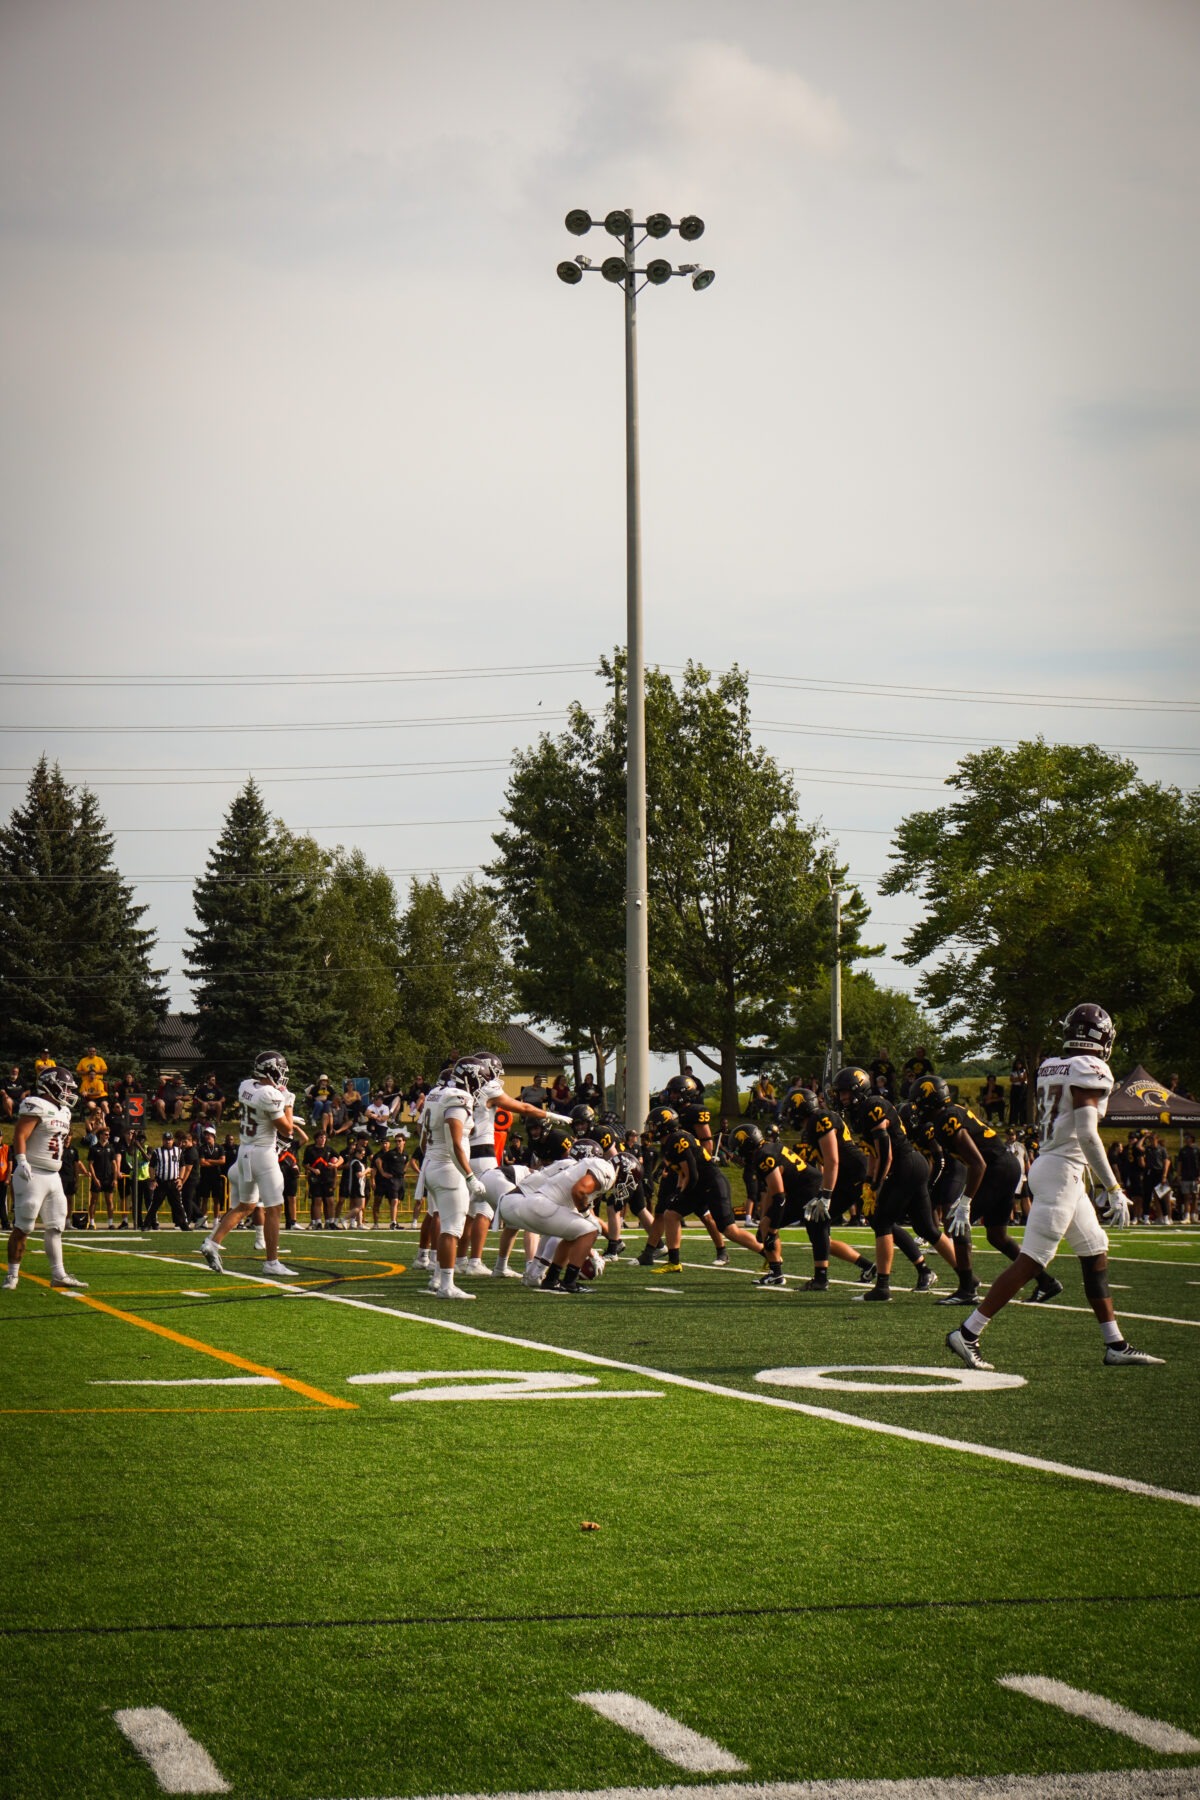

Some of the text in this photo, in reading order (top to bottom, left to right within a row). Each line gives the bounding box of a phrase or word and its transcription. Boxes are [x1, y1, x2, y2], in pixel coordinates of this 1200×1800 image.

[129, 1097, 144, 1117] 3
[868, 1106, 886, 1121] 12
[698, 1111, 710, 1123] 35
[815, 1116, 833, 1133] 43
[942, 1116, 961, 1136] 32
[600, 1133, 611, 1148] 27
[673, 1137, 689, 1154] 26
[759, 1156, 775, 1172] 50
